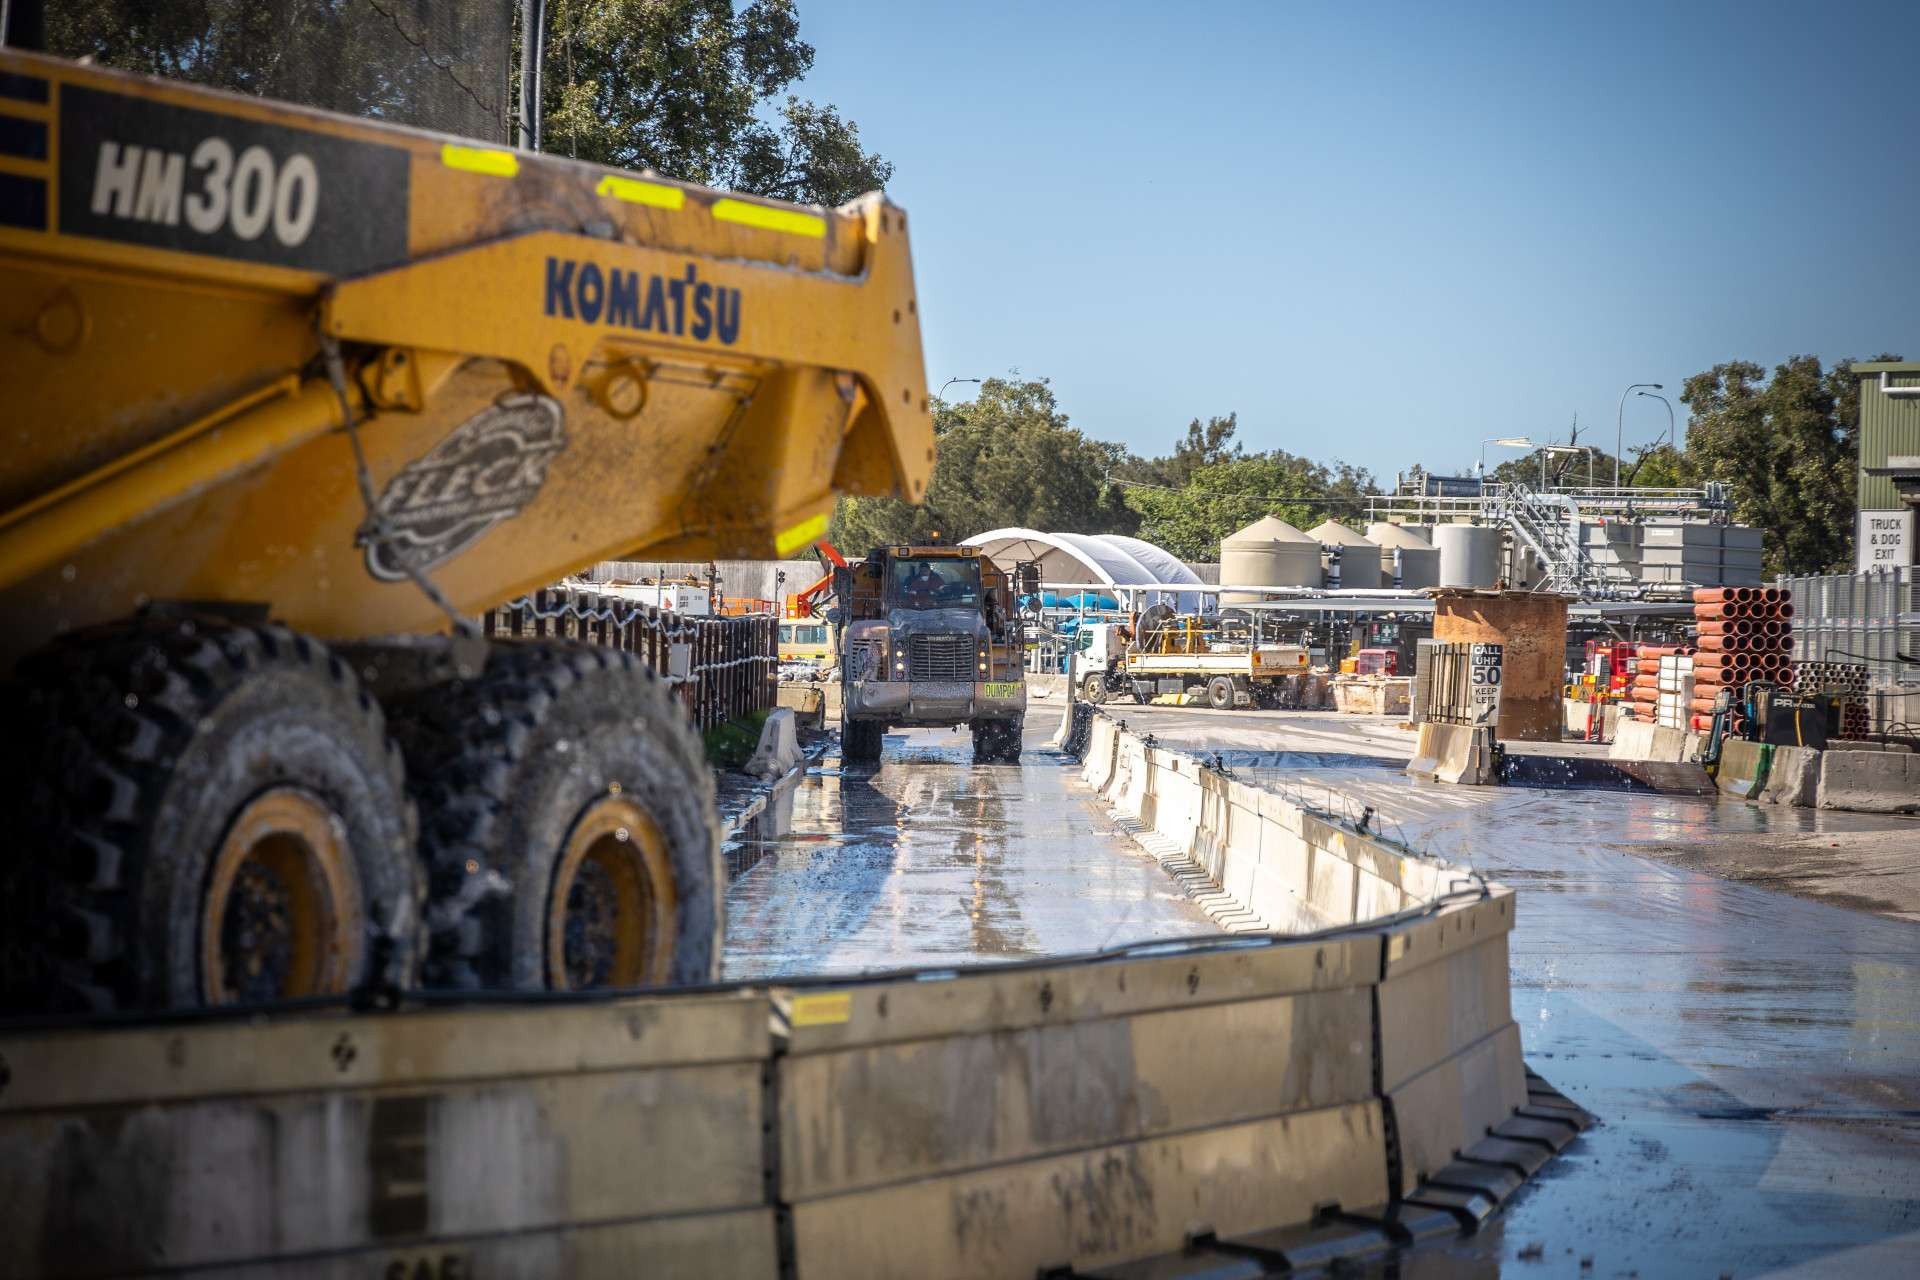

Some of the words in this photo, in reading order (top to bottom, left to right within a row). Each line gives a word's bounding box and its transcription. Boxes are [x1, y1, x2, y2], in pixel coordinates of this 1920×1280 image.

[91, 137, 318, 246] HM300
[544, 257, 740, 345] KOMATSU
[1870, 519, 1902, 530] TRUCK
[1871, 534, 1878, 545] &
[1881, 534, 1901, 545] DOG
[1875, 549, 1895, 559] EXIT
[1474, 646, 1501, 655] CALL
[1476, 656, 1498, 665] UHF
[1472, 667, 1500, 685] 50
[1475, 687, 1497, 695] KEEP
